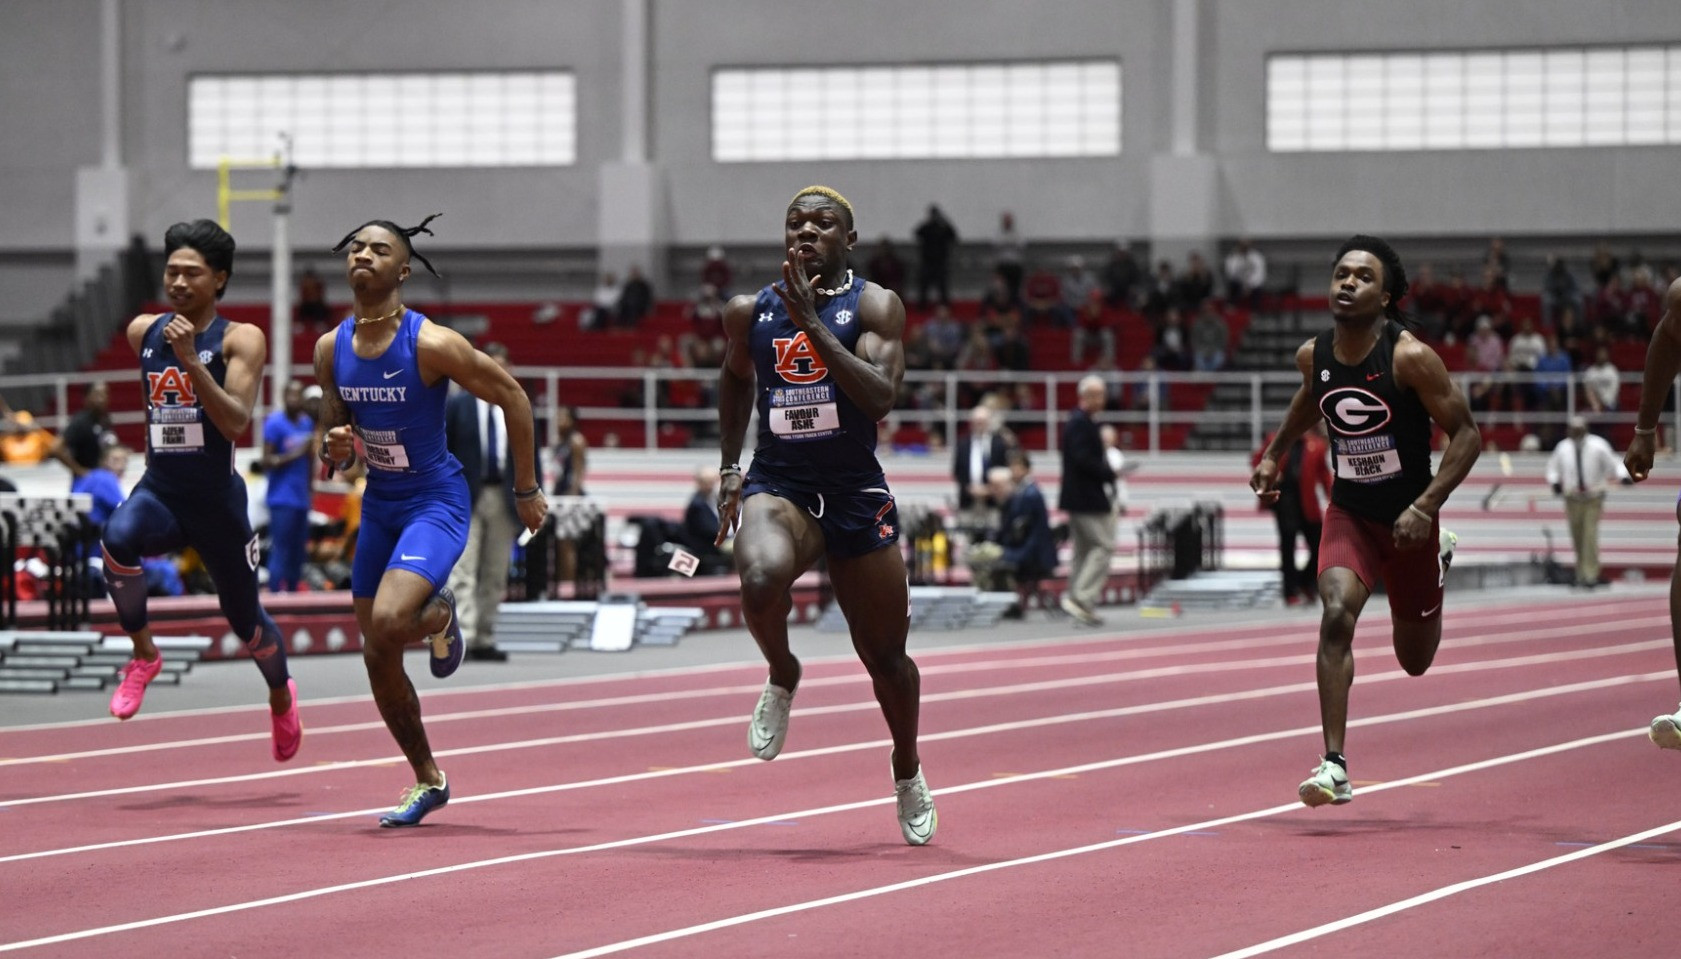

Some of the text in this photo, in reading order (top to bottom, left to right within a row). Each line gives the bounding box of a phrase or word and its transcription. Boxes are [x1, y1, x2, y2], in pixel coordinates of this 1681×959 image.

[339, 386, 406, 402] KENTUCKY
[785, 407, 819, 420] FAVOUR
[791, 419, 815, 431] ASHE
[1348, 454, 1386, 467] KESHAUN
[1355, 465, 1382, 476] BLACK
